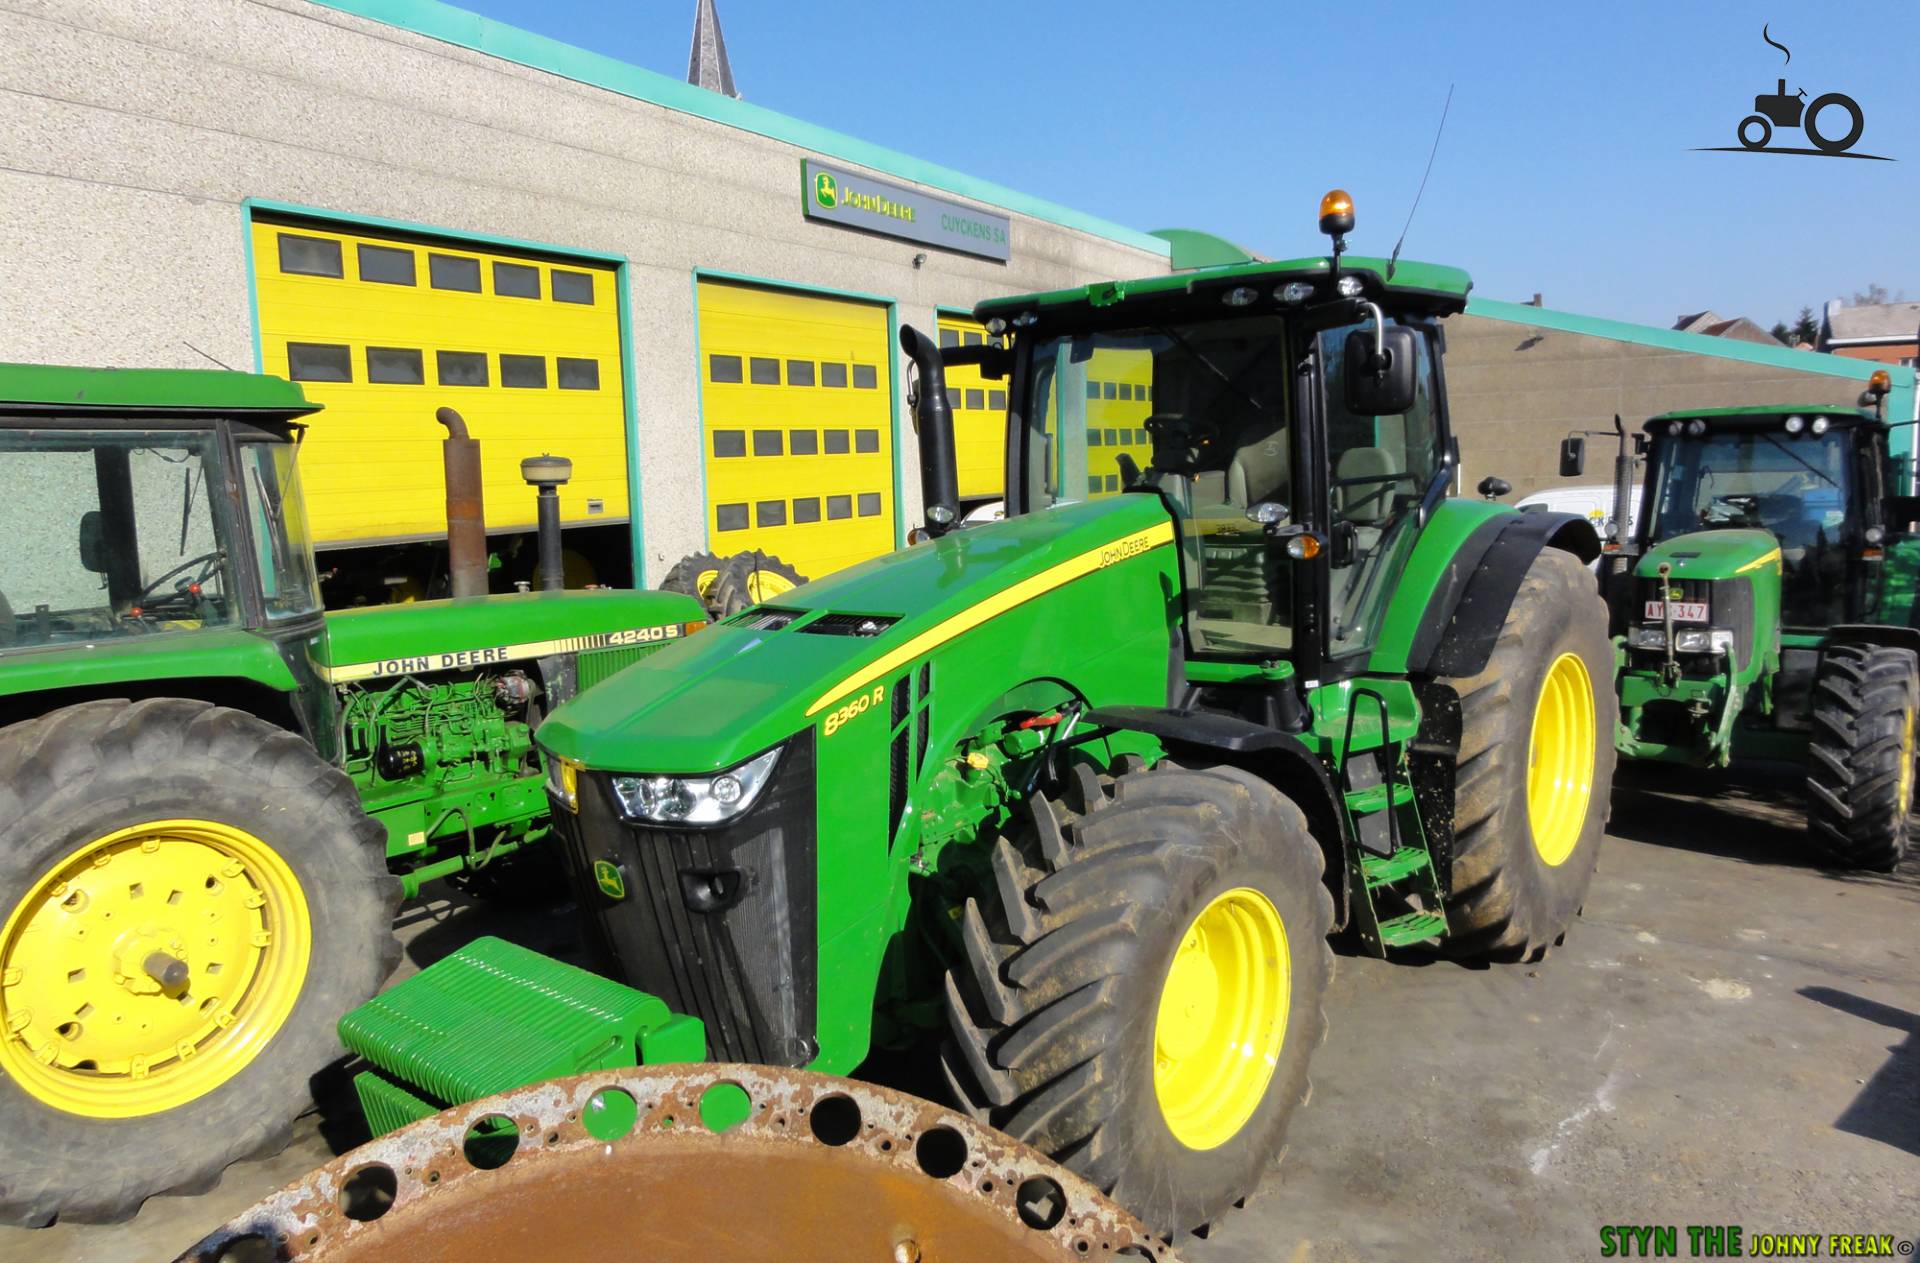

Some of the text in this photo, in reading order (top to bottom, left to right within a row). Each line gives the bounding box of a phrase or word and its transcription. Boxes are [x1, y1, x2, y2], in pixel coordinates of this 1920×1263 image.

[941, 213, 1006, 245] CUYCKENS SA
[373, 647, 508, 675] JOHN DEERE
[824, 685, 884, 736] 8360 R
